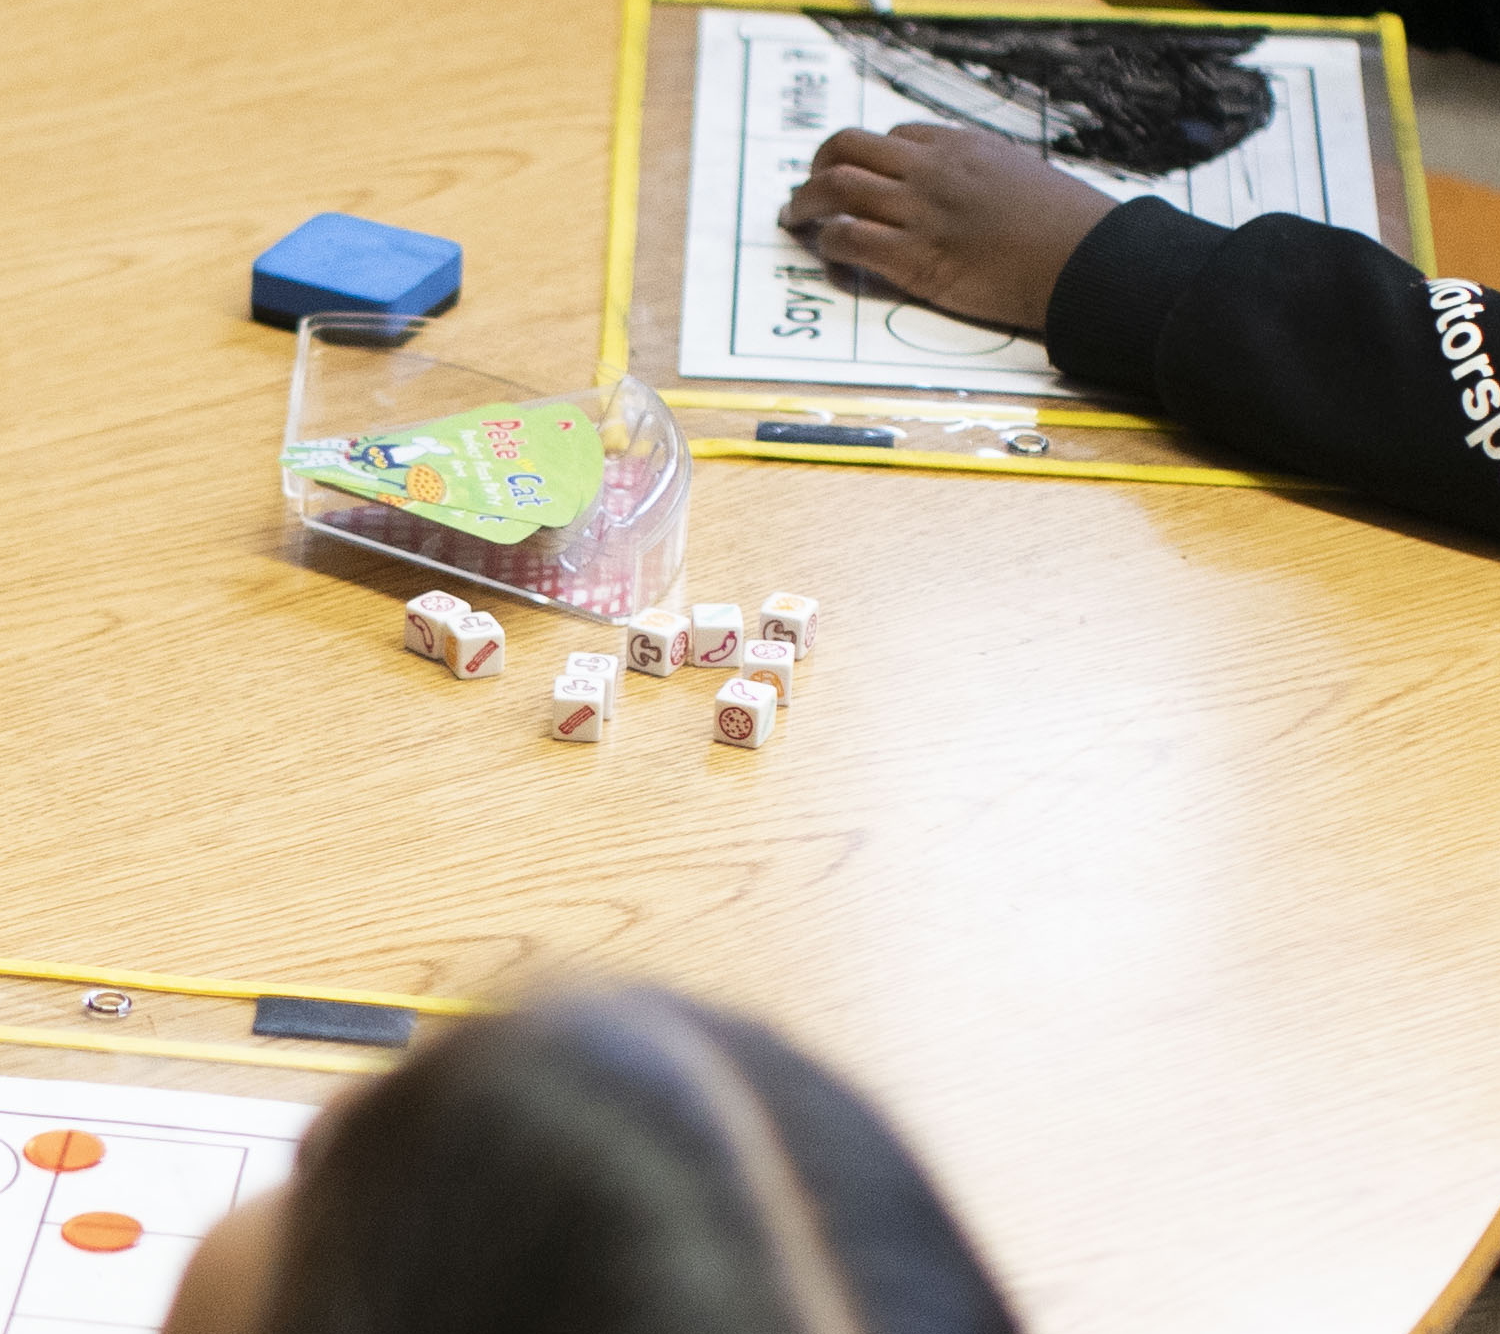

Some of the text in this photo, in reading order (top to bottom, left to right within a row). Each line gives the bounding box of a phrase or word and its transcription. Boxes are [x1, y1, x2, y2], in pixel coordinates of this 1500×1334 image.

[772, 288, 836, 341] Say
[480, 419, 527, 460] Pete
[507, 473, 552, 507] Cat
